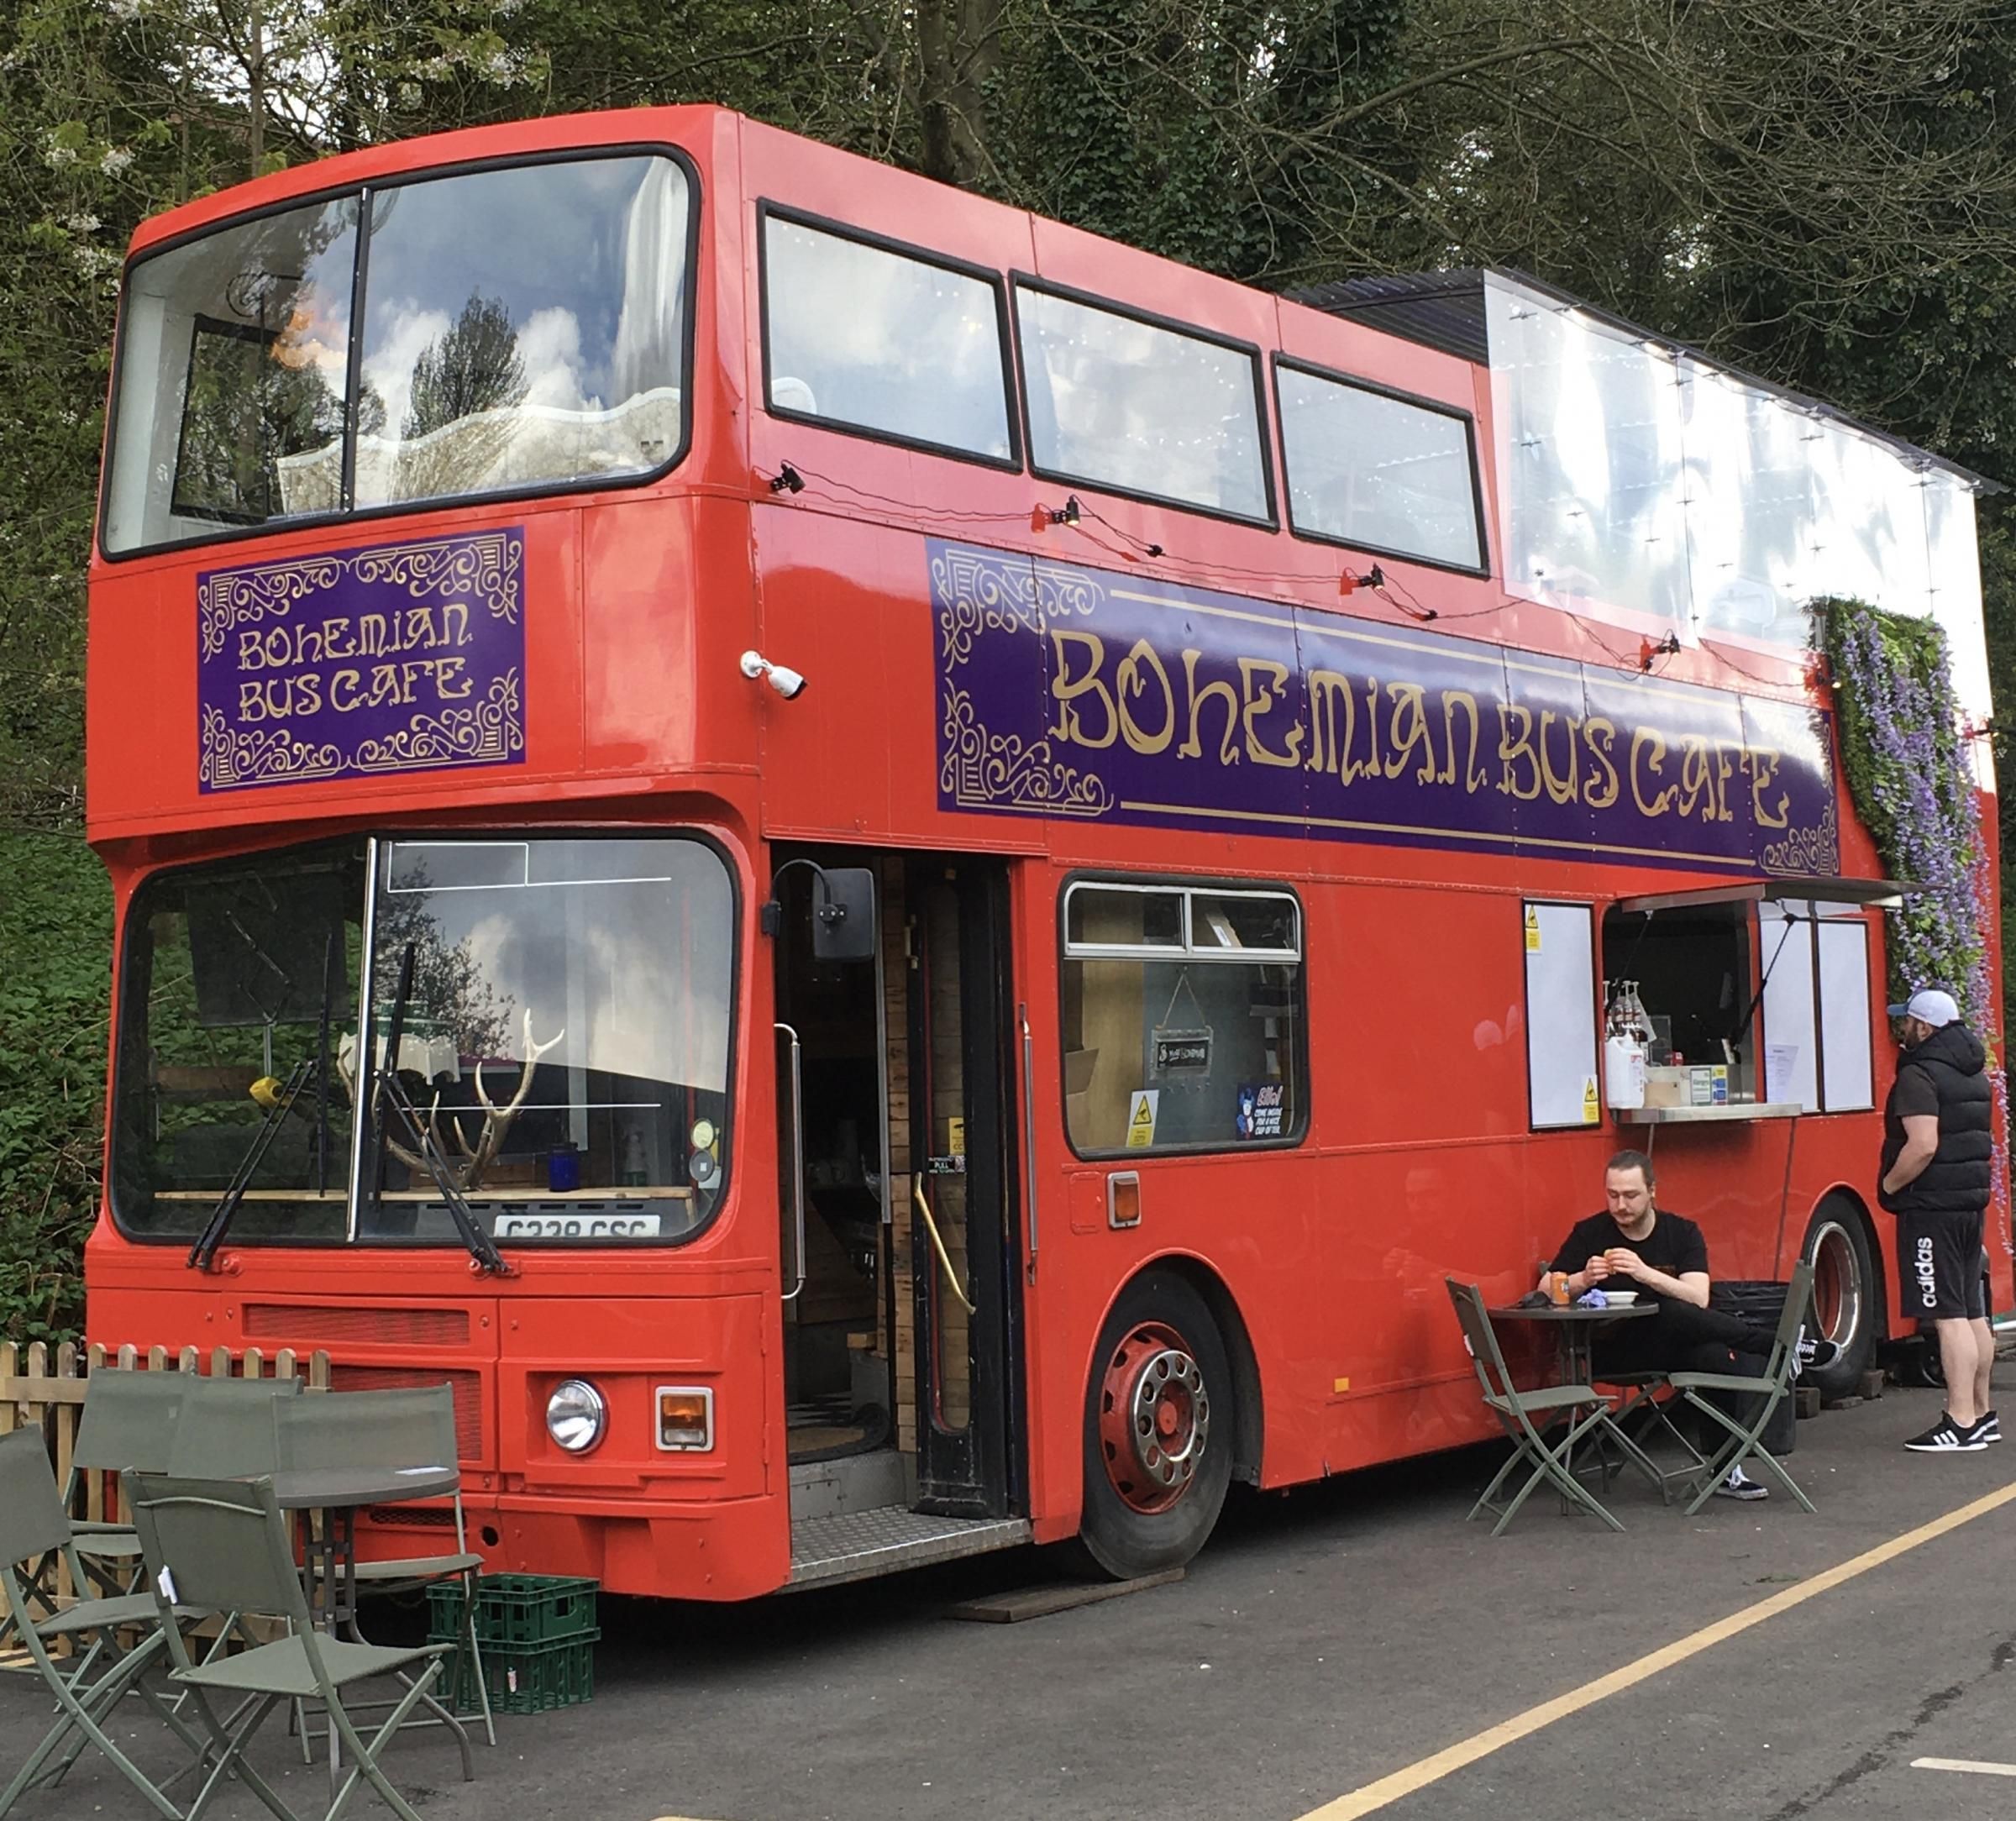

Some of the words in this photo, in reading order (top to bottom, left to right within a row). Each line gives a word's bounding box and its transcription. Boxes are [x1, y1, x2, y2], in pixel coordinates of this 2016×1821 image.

[238, 604, 473, 671] BOHEMIAN
[238, 674, 322, 722] BUS
[330, 657, 474, 712] CAFE
[1047, 630, 1488, 794] BOHEMIAN
[1496, 703, 1620, 808] BUS
[1630, 726, 1791, 828] CAFE
[1914, 1236, 1937, 1308] adidas
